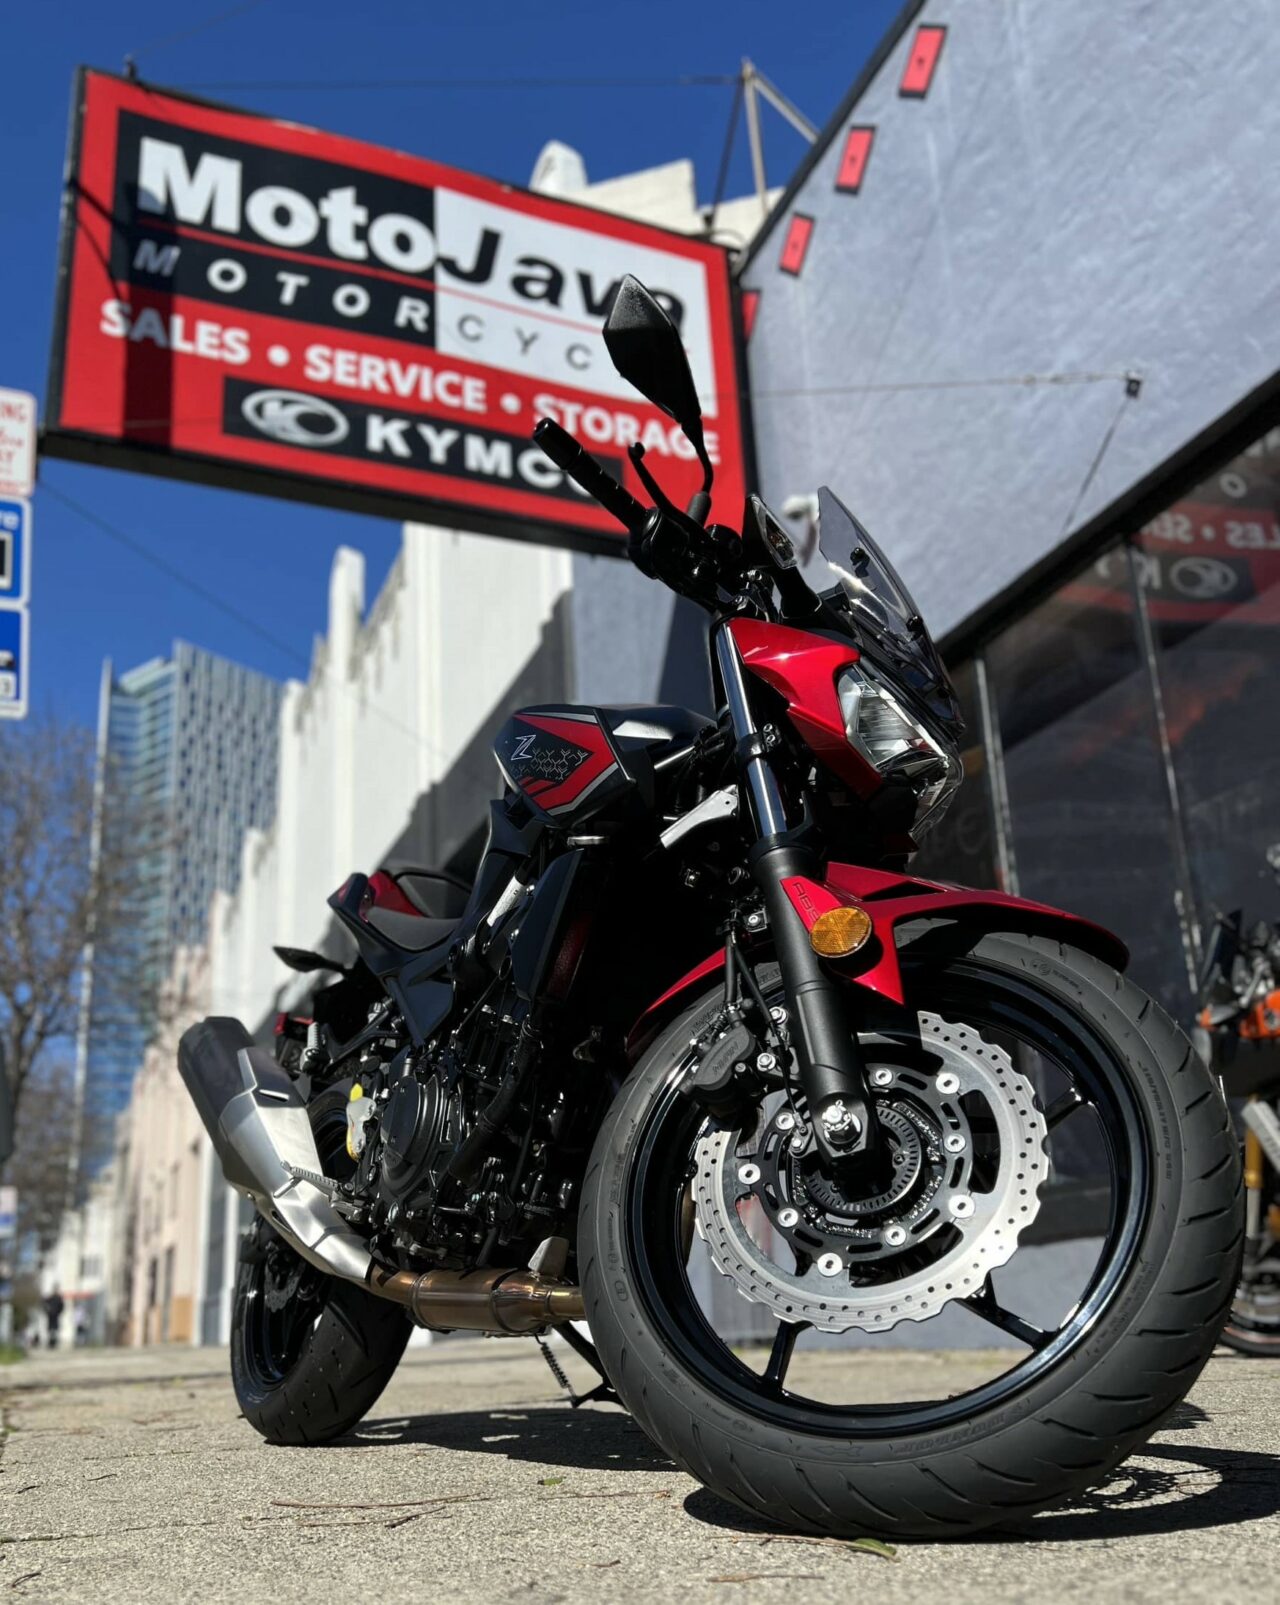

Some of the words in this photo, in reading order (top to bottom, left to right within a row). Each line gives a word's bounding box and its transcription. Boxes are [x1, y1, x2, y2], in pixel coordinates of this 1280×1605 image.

[133, 239, 591, 371] MOTORCYC
[100, 298, 251, 364] SALES
[304, 343, 487, 413] SERVICE
[533, 393, 720, 465] STORAGE
